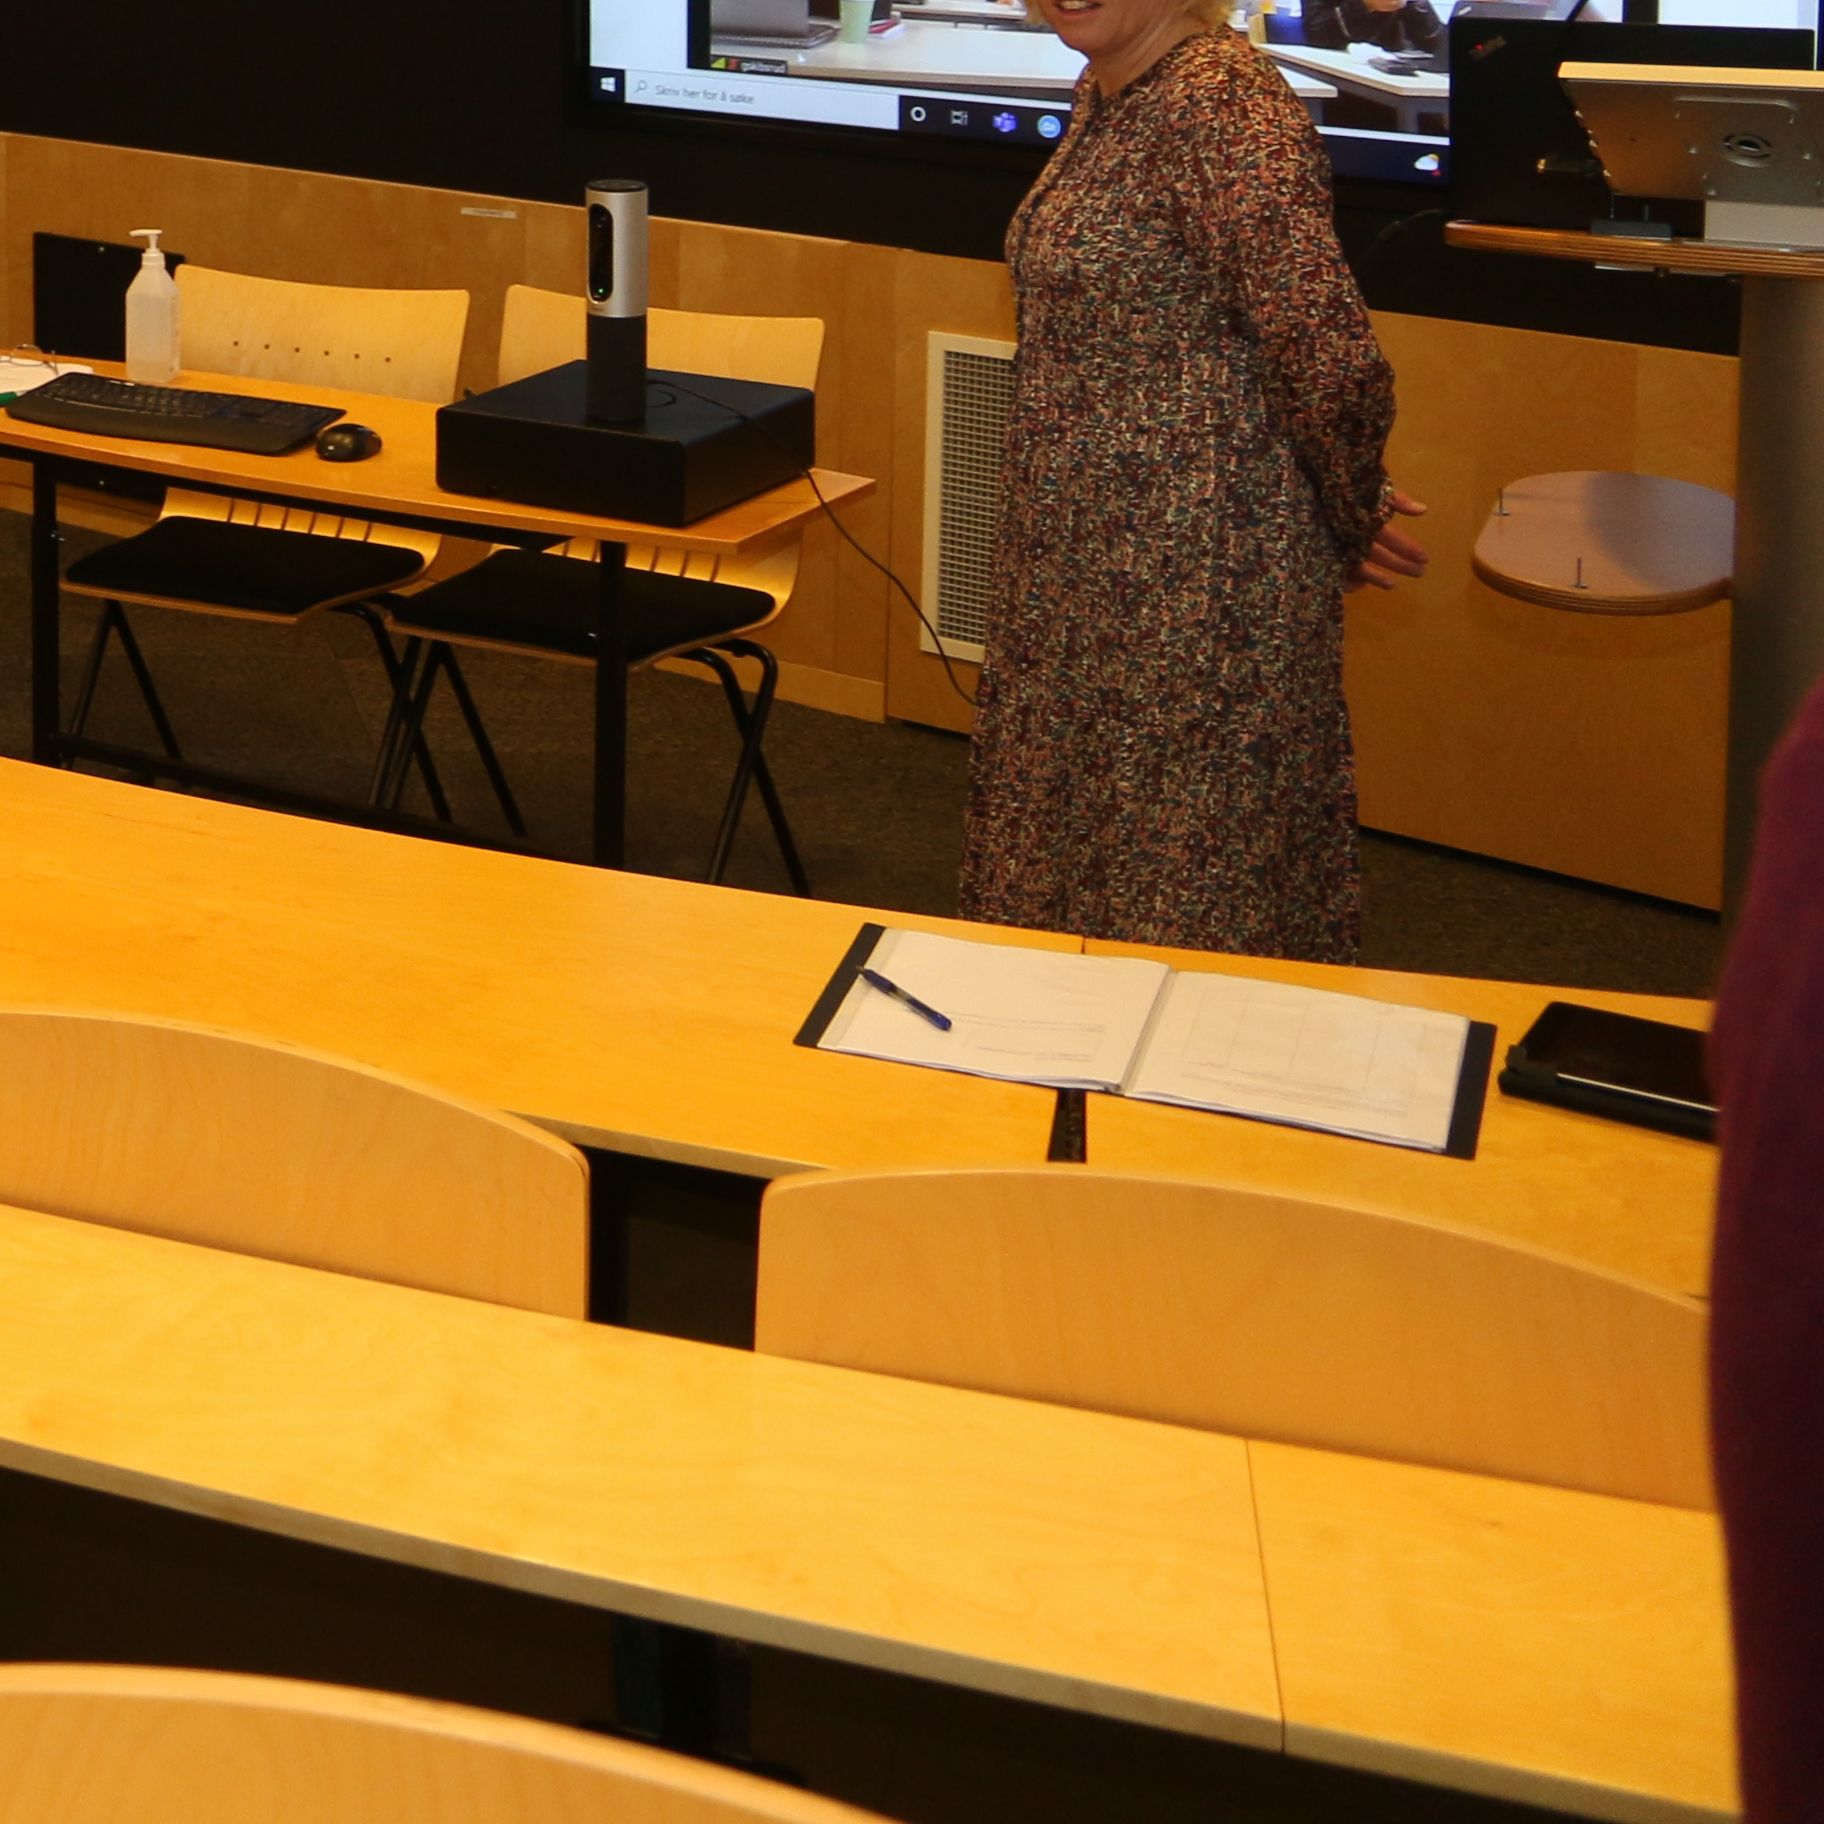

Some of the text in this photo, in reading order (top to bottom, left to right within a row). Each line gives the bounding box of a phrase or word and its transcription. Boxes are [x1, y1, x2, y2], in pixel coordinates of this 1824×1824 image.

[655, 84, 679, 97] Skriv
[683, 87, 700, 98] her
[702, 89, 718, 100] for
